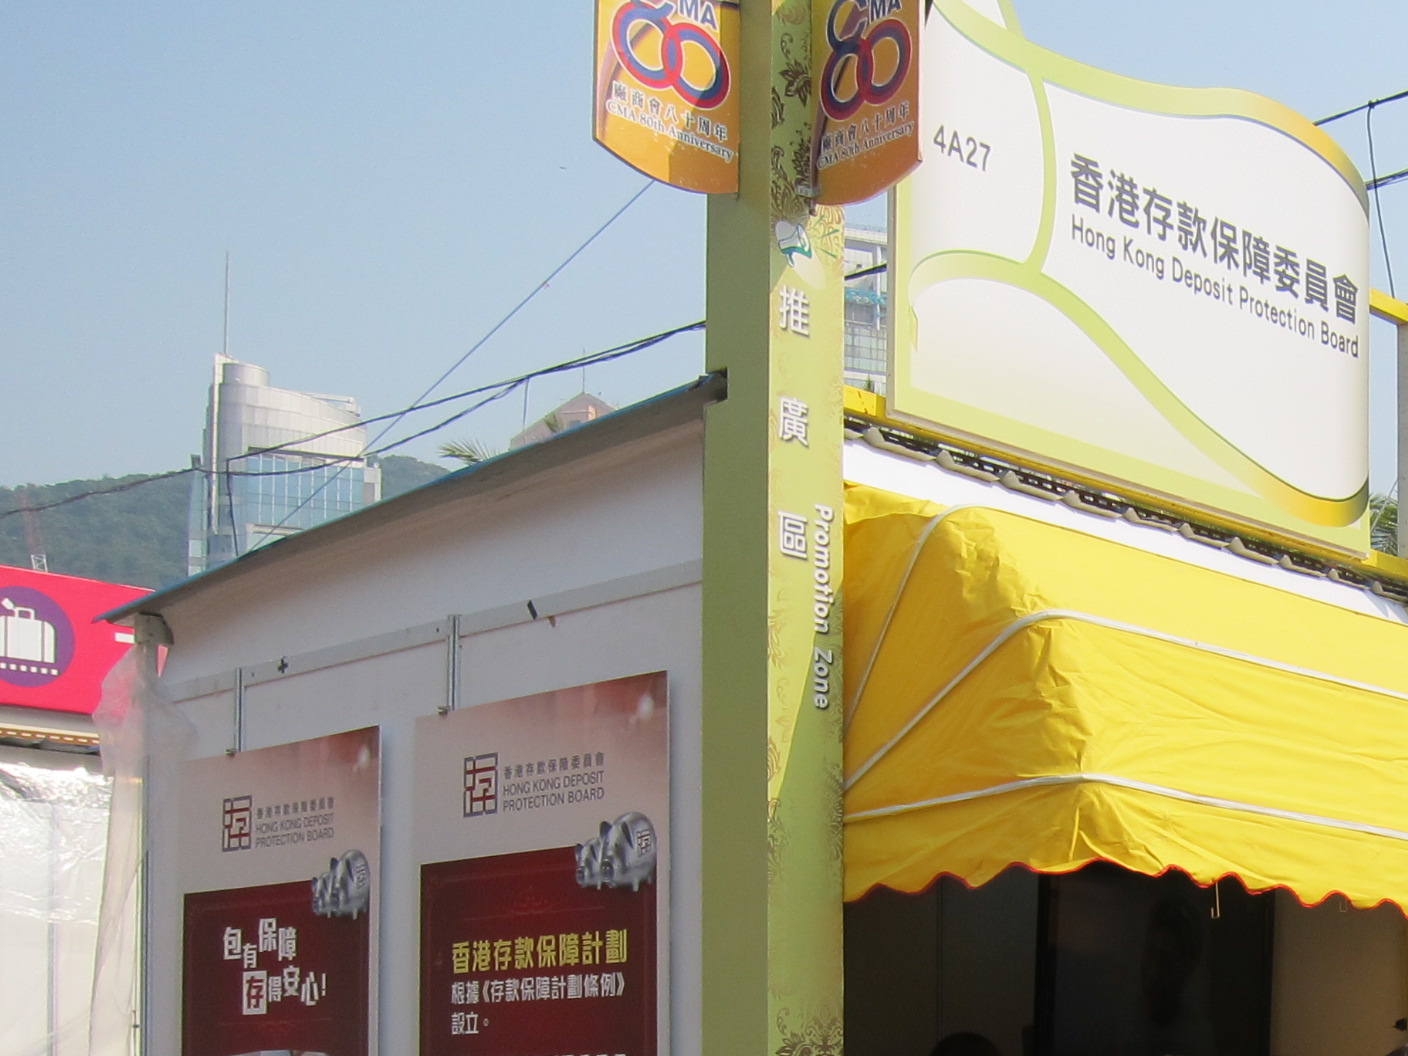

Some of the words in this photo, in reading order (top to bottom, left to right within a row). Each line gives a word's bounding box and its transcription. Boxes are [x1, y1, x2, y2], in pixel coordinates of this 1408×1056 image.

[605, 100, 637, 123] CMA
[639, 114, 666, 134] 80th
[667, 125, 735, 163] Anniversary
[613, 81, 730, 142] 廠商會八十周年
[821, 101, 909, 152] 廠商會八十周年
[818, 153, 839, 168] CMA
[839, 144, 861, 160] 80th
[863, 122, 914, 150] Anniversary
[933, 125, 992, 172] 4A27
[1070, 152, 1359, 325] 香港存款保障委員會
[1071, 214, 1117, 260] Hong
[1123, 241, 1166, 281] Kong
[1172, 254, 1234, 306] Deposit
[1239, 285, 1315, 341] Protection
[1320, 324, 1360, 359] Board
[778, 283, 811, 562] 推廣區
[813, 503, 834, 634] Promotion
[813, 645, 834, 711] Zone
[503, 752, 605, 780] 香港存款保障委員會
[503, 783, 531, 797] HONG
[532, 777, 561, 792] KONG
[563, 770, 605, 787] DEPOSIT
[256, 796, 335, 820] 香港存款保障委員會
[503, 793, 565, 812] PROTECTION
[567, 787, 605, 804] BOARD
[256, 820, 279, 834] HONG
[280, 817, 302, 831] KONG
[303, 812, 334, 827] DEPOSIT
[256, 831, 305, 848] PROTECTION
[306, 827, 334, 841] BOARD
[452, 929, 628, 974] 香港存款保障計劃
[451, 972, 626, 1005] 根據《存款保障計劃條例》
[451, 1012, 490, 1035] 設立。
